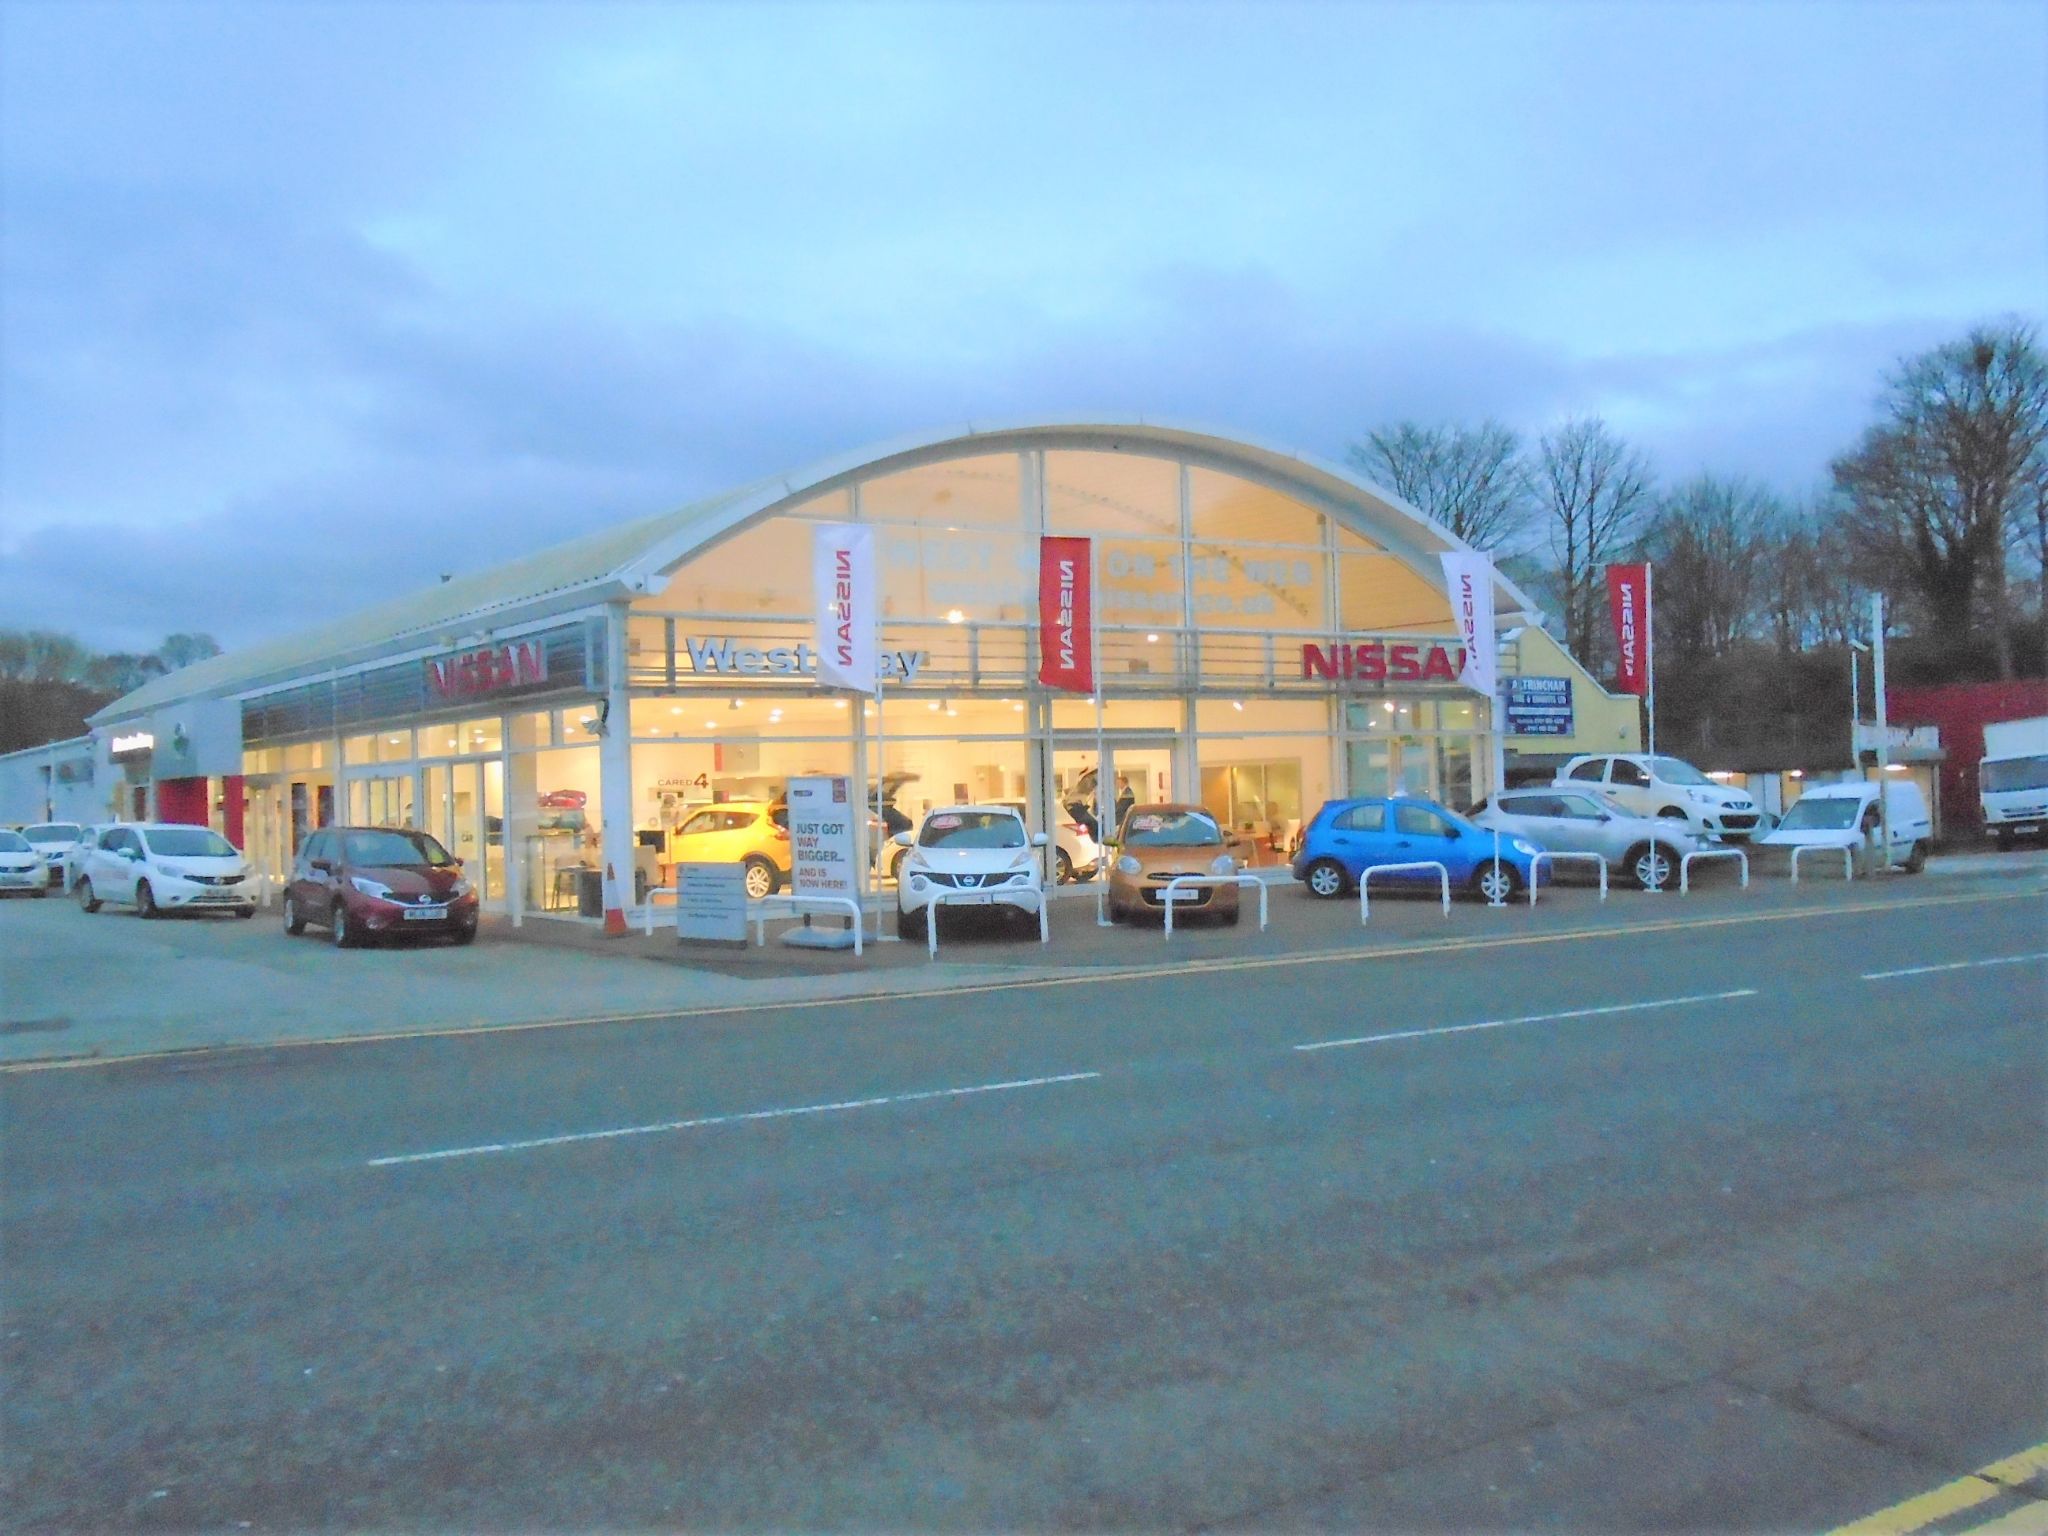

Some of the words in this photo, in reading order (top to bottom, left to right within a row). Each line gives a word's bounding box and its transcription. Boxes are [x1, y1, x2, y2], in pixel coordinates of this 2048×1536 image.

[693, 772, 710, 789] 4
[796, 823, 819, 835] JUST
[821, 823, 845, 835] GOT
[797, 837, 819, 848] WAY
[799, 867, 817, 878] AND
[818, 868, 827, 878] IS
[799, 879, 819, 889] NOW
